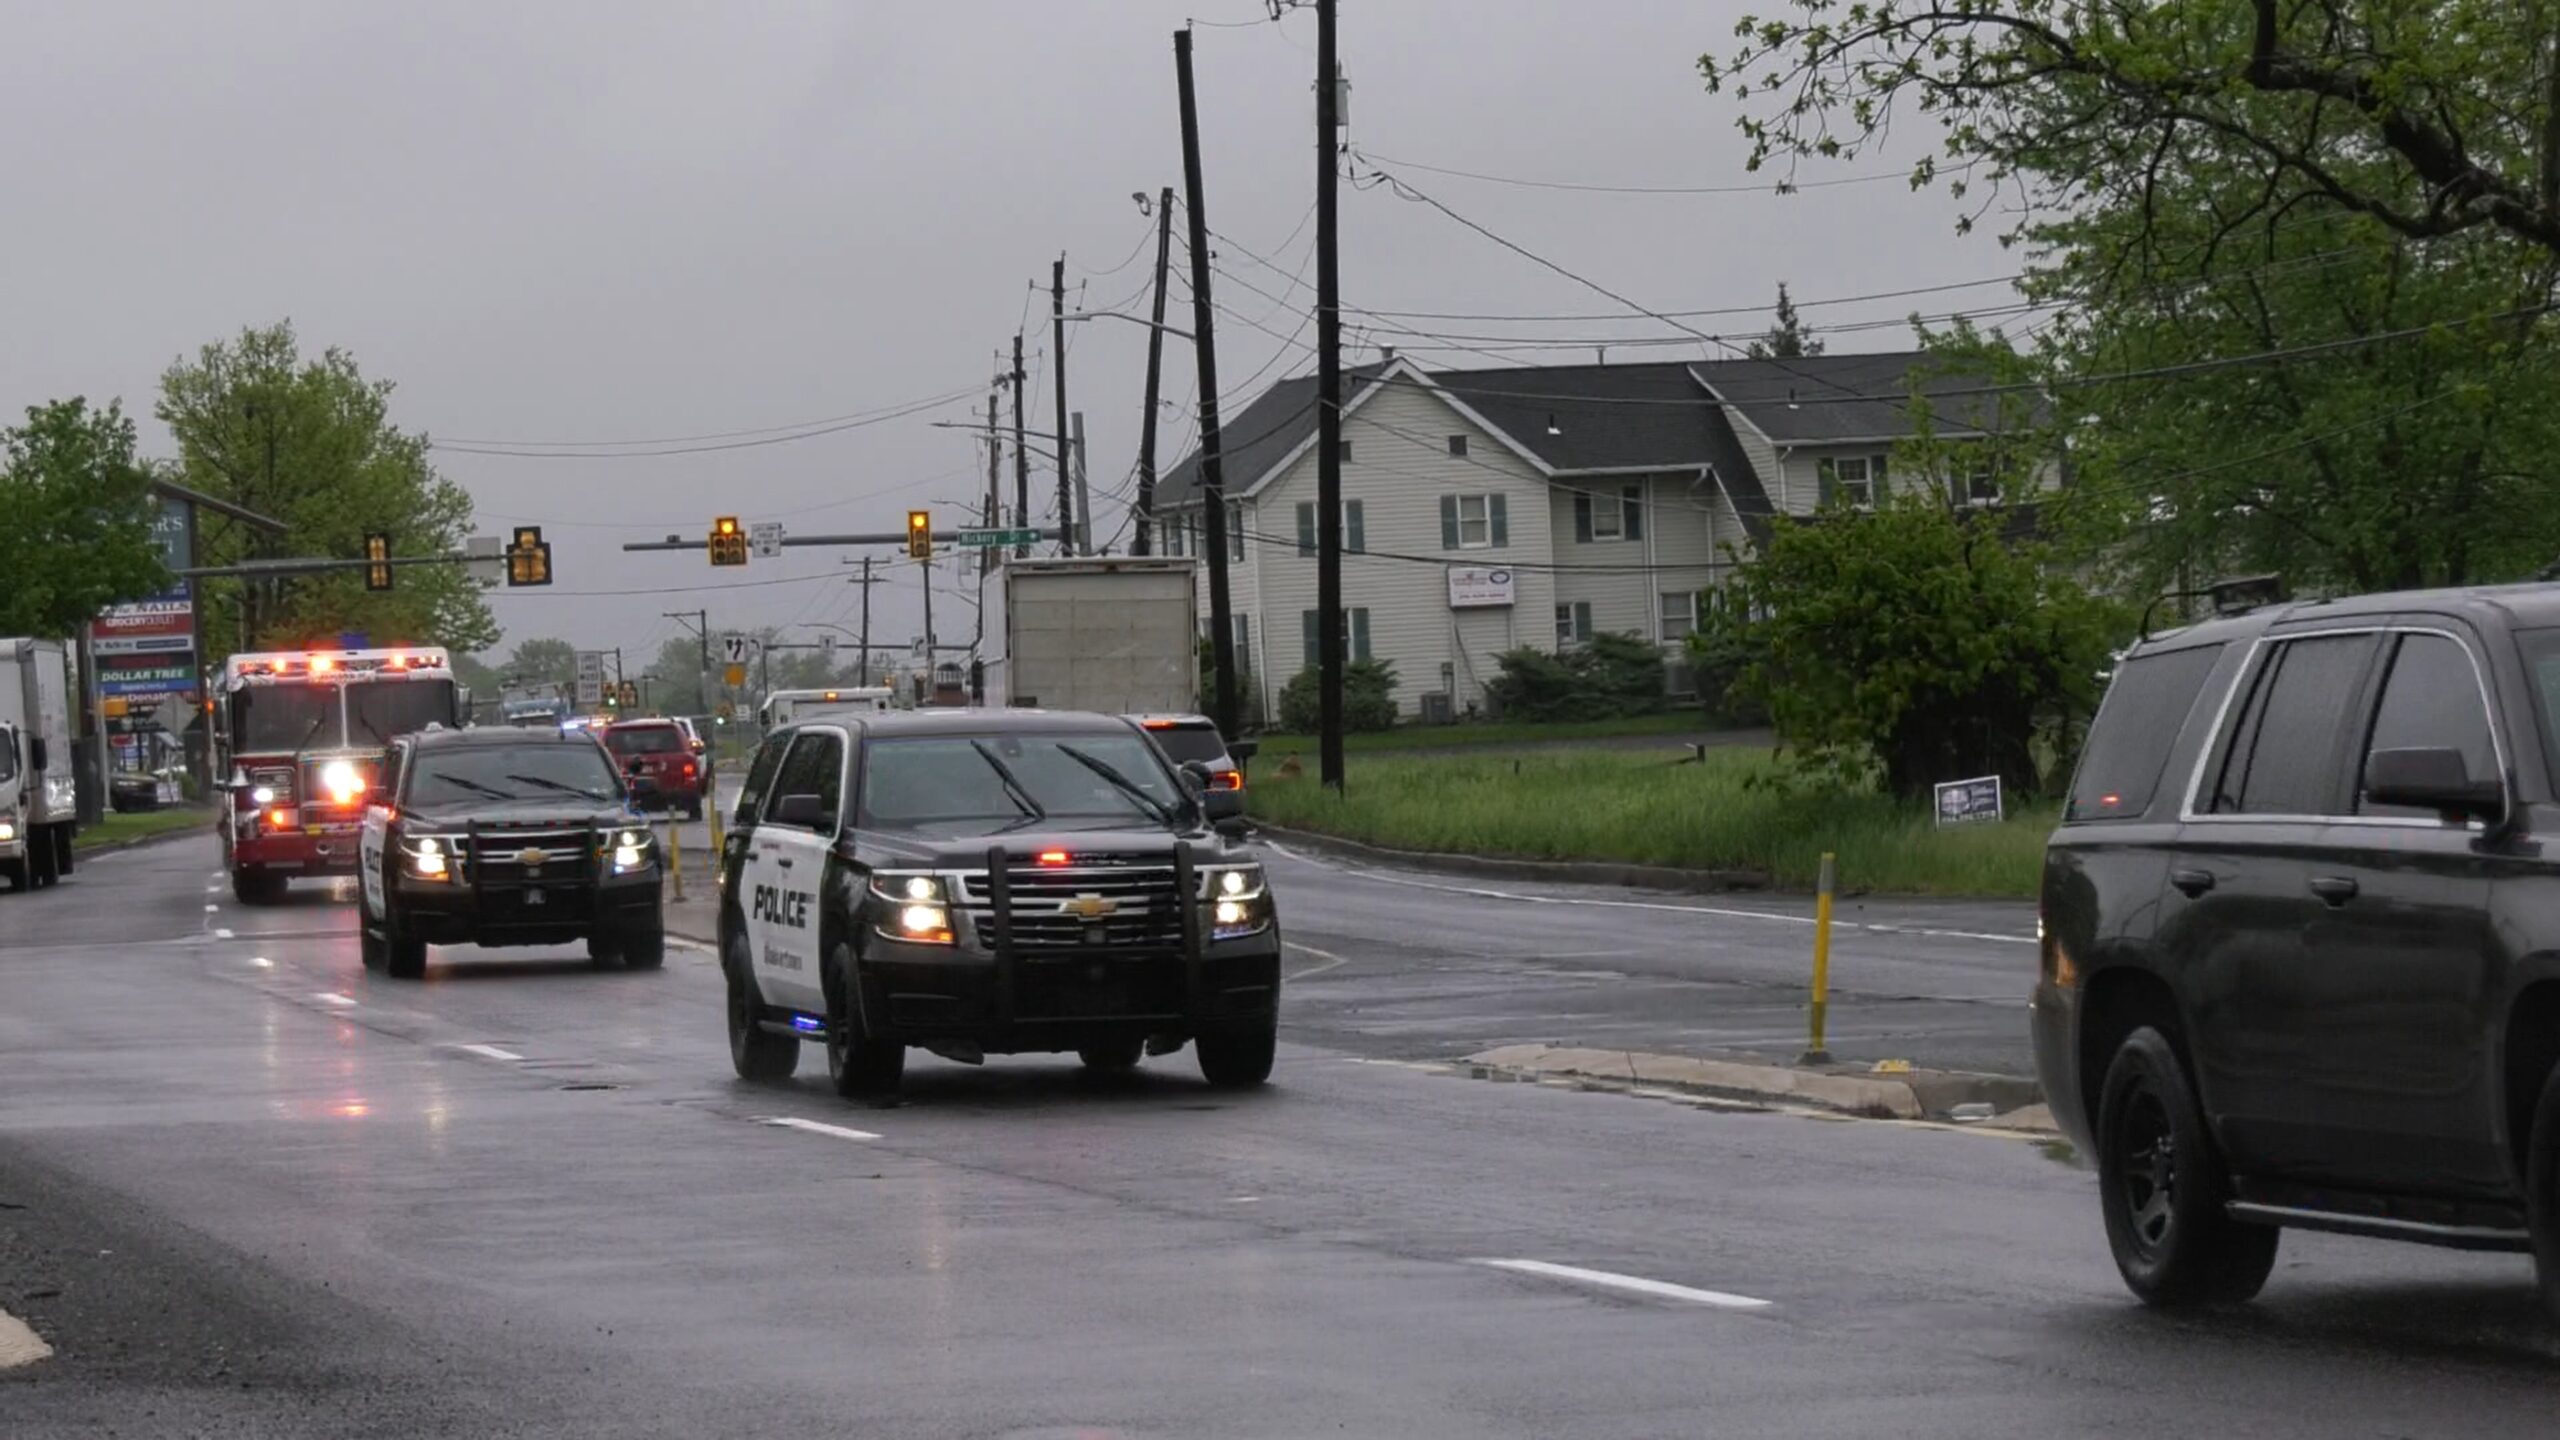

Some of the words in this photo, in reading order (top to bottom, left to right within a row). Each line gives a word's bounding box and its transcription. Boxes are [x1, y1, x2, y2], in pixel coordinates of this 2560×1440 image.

[137, 602, 189, 615] NAILS
[106, 616, 145, 628] GROCERY
[102, 670, 151, 682] DOLLAR
[153, 668, 185, 680] TREE
[754, 884, 806, 929] POLICE
